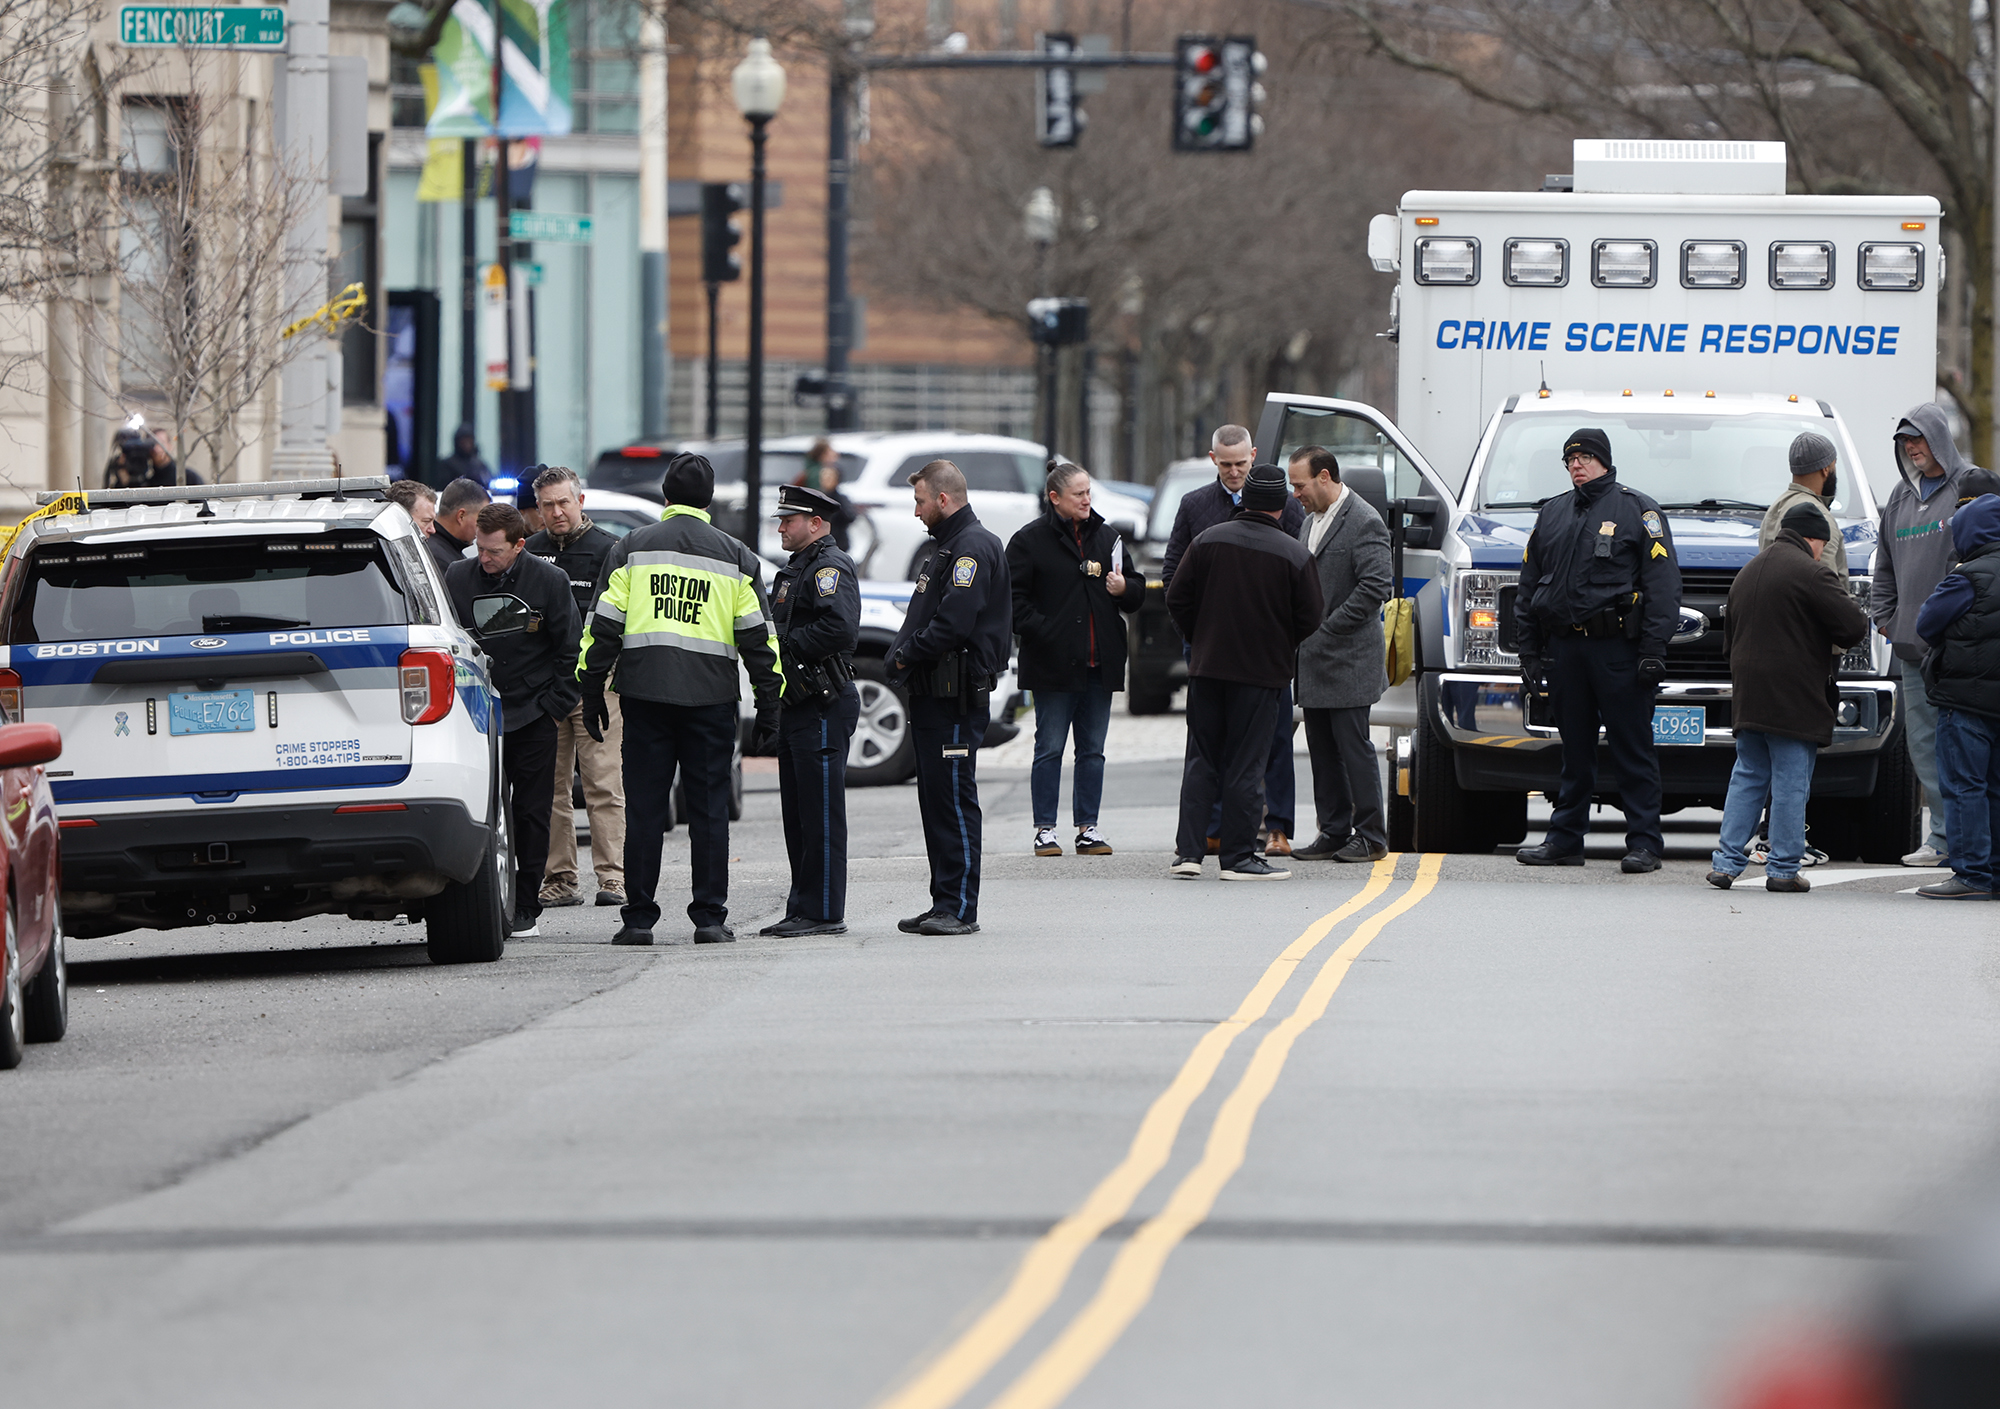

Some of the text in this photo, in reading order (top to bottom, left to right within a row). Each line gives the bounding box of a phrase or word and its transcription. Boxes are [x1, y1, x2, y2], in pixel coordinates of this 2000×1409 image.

[260, 9, 279, 21] PVT
[124, 10, 247, 43] FENCOURT ST
[258, 30, 281, 42] WAY
[1436, 320, 1901, 355] CRIME SCENE RESPONSE
[650, 573, 711, 603] BOSTON
[654, 597, 703, 625] POLICE
[269, 629, 371, 645] POLICE
[36, 639, 160, 658] BOSTON
[187, 692, 235, 702] Massachusetts
[202, 700, 252, 723] E762
[1660, 716, 1700, 735] C965
[275, 739, 360, 754] CRIME STOPPERS
[275, 752, 361, 767] 1-800-494-TIPS
